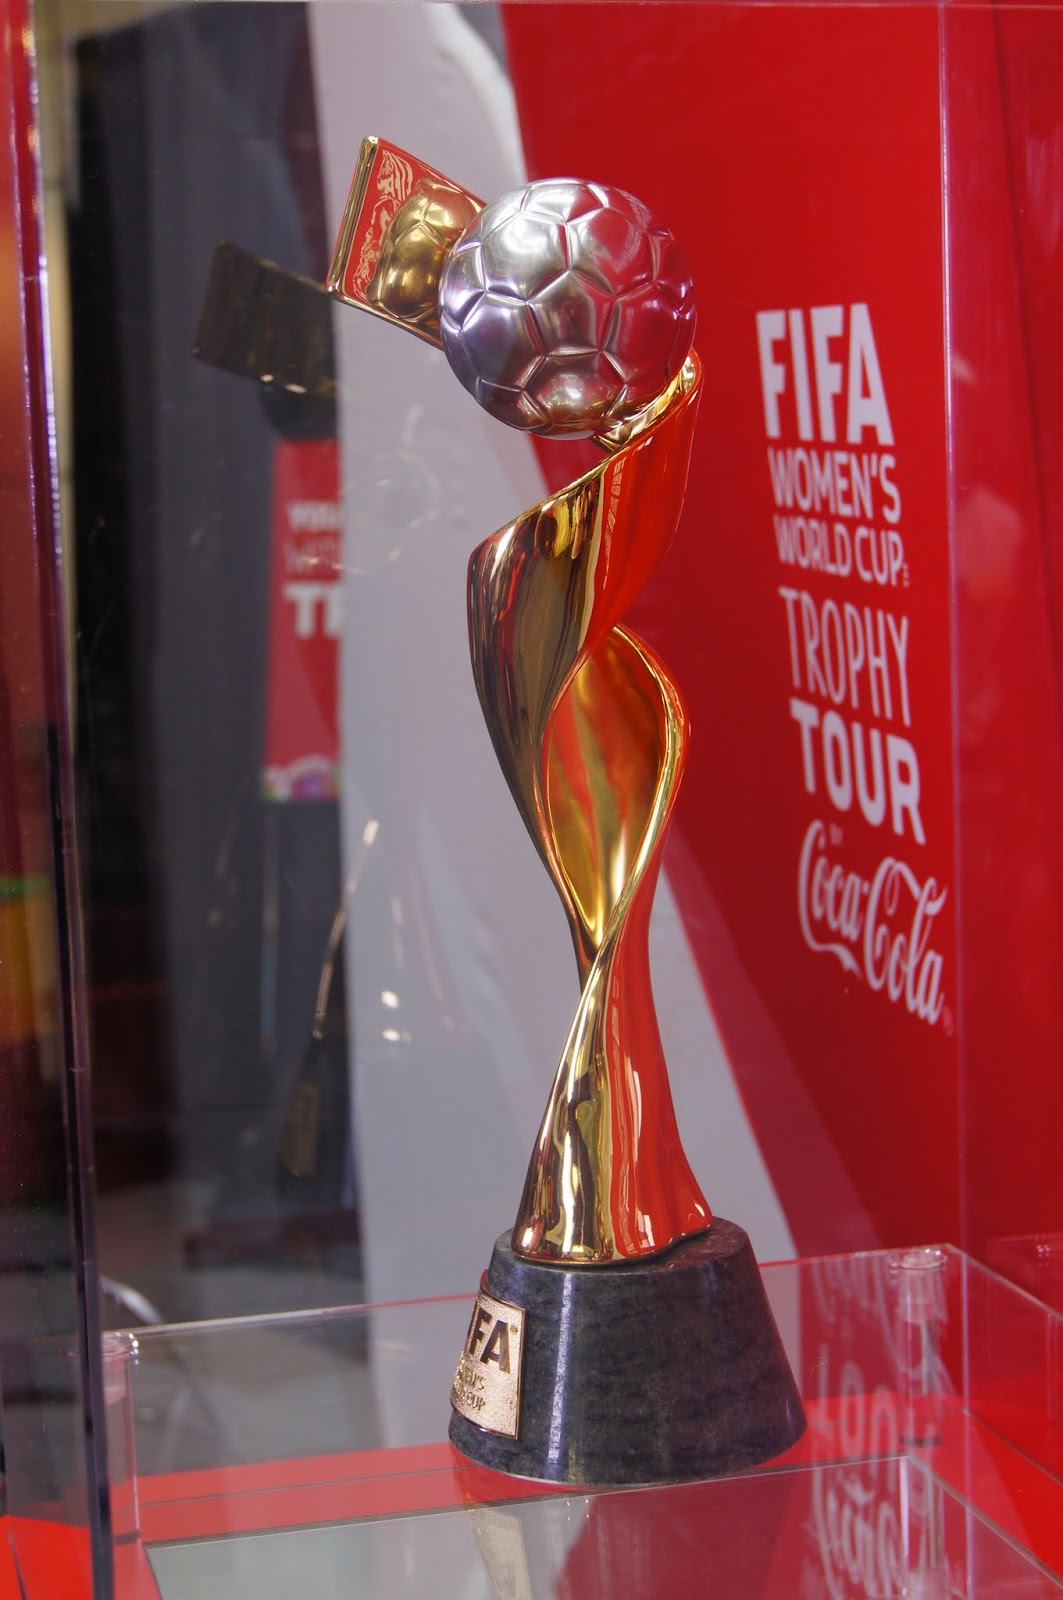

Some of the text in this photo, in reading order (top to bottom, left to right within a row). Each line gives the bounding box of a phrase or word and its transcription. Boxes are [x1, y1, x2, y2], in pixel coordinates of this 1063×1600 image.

[756, 303, 895, 446] FIFA
[767, 447, 901, 524] WOMEN'S
[773, 513, 904, 587] WORLD CUP
[778, 585, 911, 727] TROPHY
[789, 697, 926, 845] TOUR
